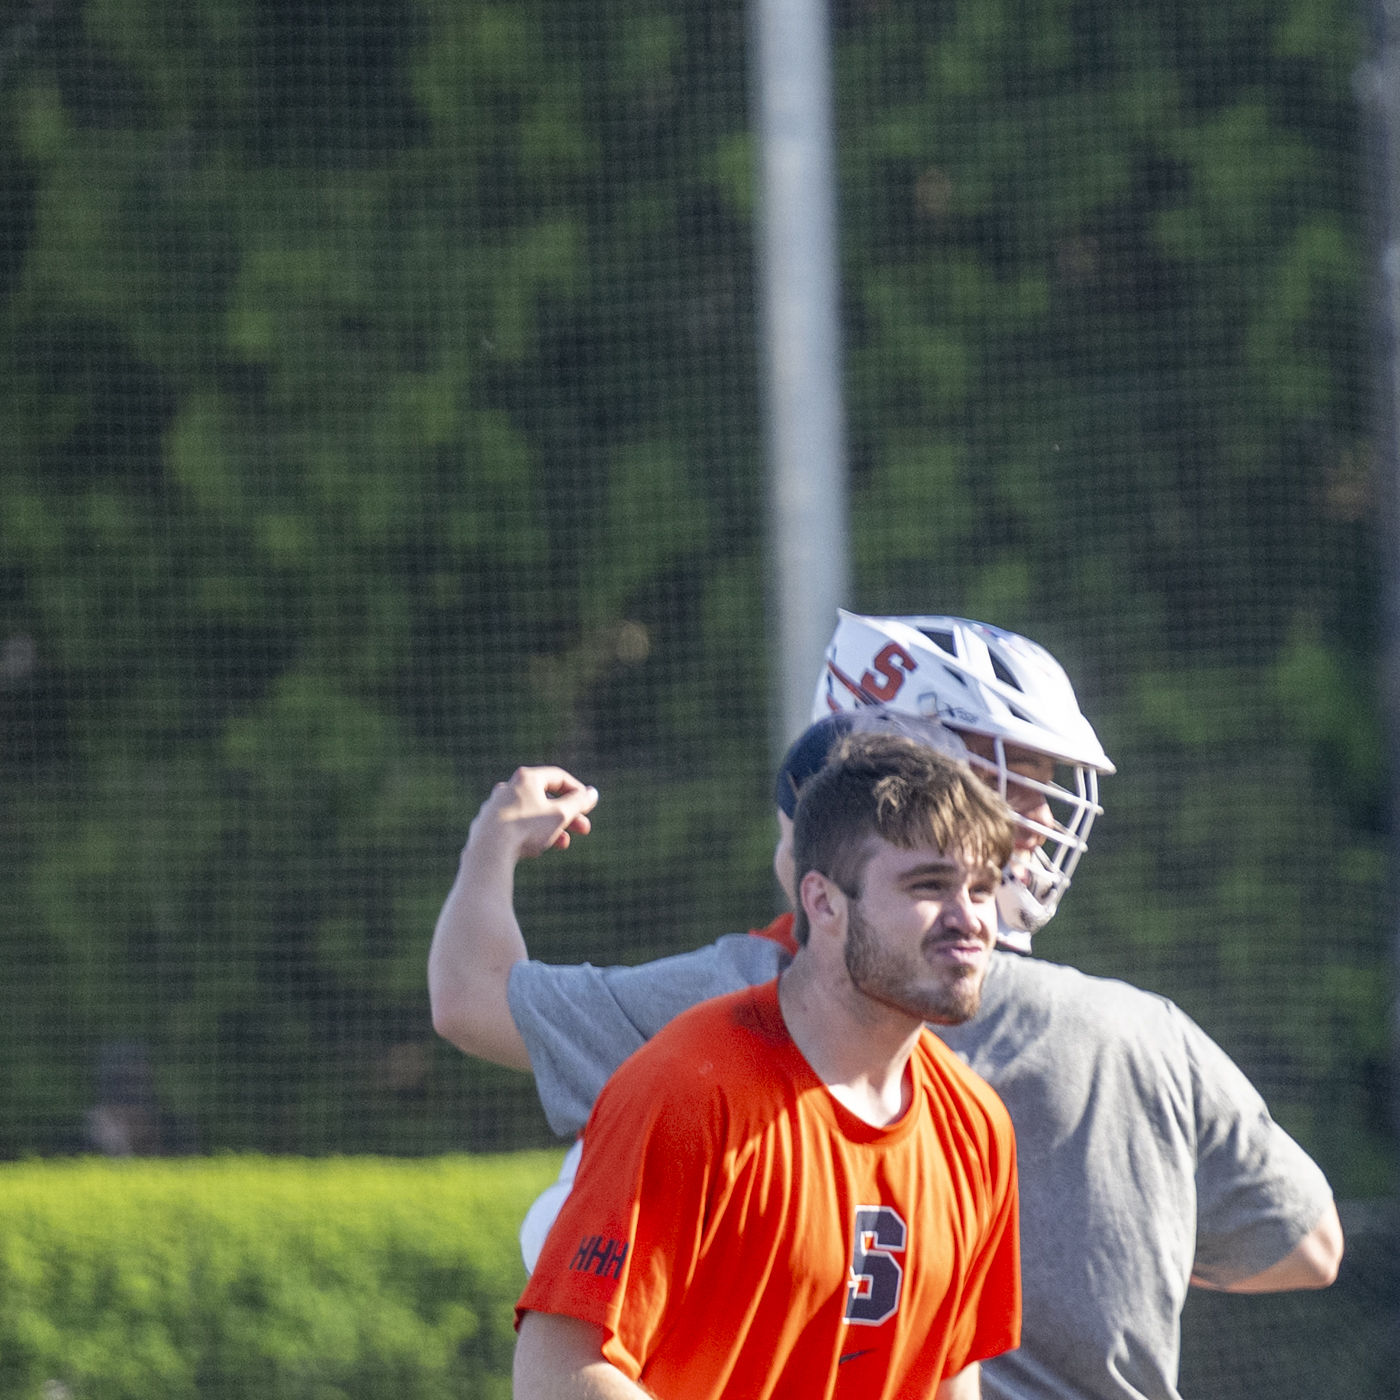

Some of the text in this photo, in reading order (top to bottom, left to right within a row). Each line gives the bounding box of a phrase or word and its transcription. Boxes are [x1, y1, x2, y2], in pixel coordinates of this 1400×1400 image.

[860, 642, 917, 702] S
[568, 1235, 630, 1280] HHH
[842, 1204, 908, 1328] S
